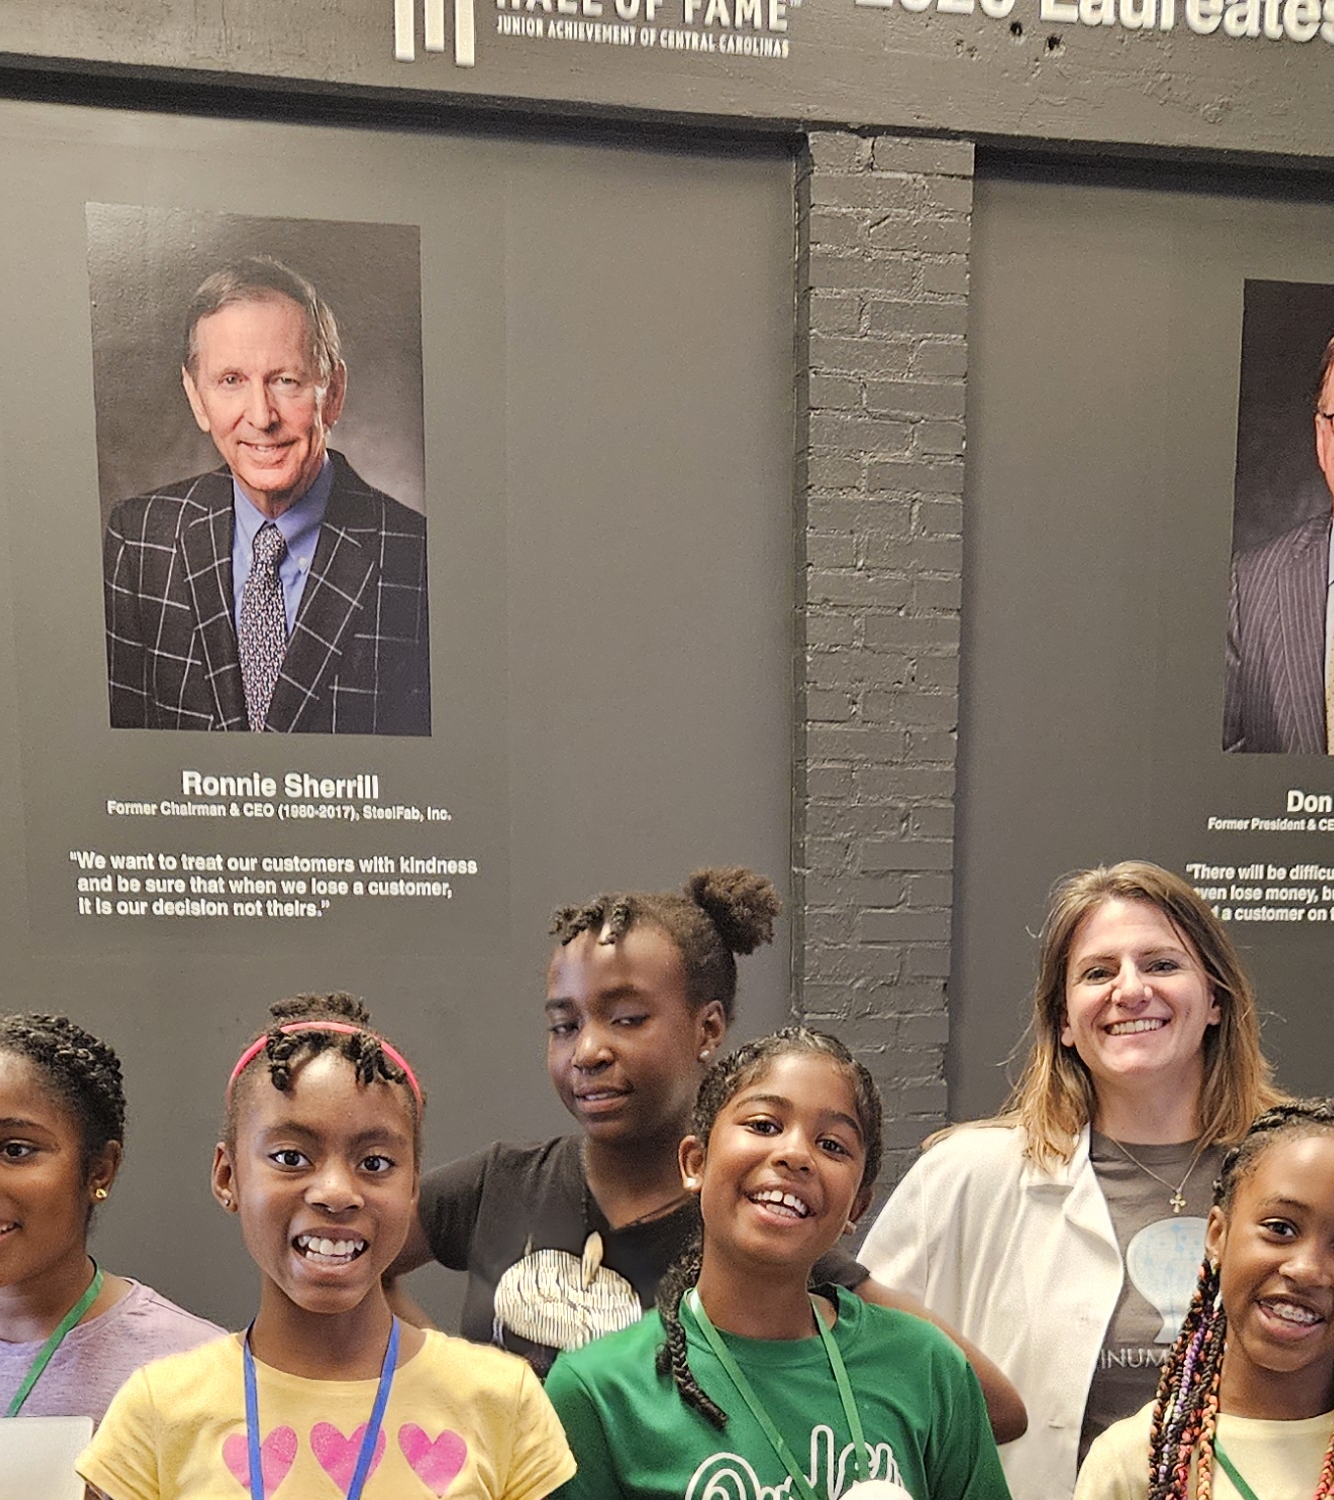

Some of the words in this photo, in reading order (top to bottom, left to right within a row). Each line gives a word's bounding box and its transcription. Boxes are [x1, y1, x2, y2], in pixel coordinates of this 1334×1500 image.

[496, 15, 544, 37] JUNIOR
[547, 20, 637, 45] ACHIEVEMENT
[640, 27, 657, 47] OF
[660, 29, 715, 52] CENTRAL
[719, 34, 789, 58] CAROLINAS
[182, 770, 277, 798] Ronnie
[284, 773, 379, 800] Sherrill
[107, 800, 158, 816] Former
[160, 801, 227, 817] Chairman
[230, 803, 241, 817] &
[243, 803, 275, 818] CEO
[278, 804, 360, 822] (1980-2017),
[362, 805, 425, 823] SteelFab,
[427, 806, 452, 821] Inc.
[1286, 790, 1333, 813] Don
[1208, 817, 1250, 831] Former
[1251, 818, 1306, 831] President
[1307, 819, 1317, 831] &
[110, 853, 155, 871] want
[157, 854, 178, 871] to
[180, 854, 224, 871] treat
[227, 858, 258, 872] our
[261, 856, 356, 873] customers
[358, 856, 396, 874] with
[399, 856, 478, 875] kindness
[1237, 864, 1265, 880] will
[1266, 864, 1287, 880] be
[77, 874, 113, 892] and
[117, 875, 142, 893] be
[145, 879, 186, 893] sure
[189, 876, 226, 893] that
[228, 877, 277, 894] when
[280, 880, 308, 895] we
[311, 878, 349, 895] lose
[352, 881, 364, 895] a
[367, 880, 454, 899] customer,
[1230, 885, 1263, 901] lose
[1265, 888, 1319, 905] money,
[95, 897, 113, 914] is
[116, 901, 149, 915] our
[151, 898, 230, 916] decision
[232, 900, 263, 917] not
[1221, 907, 1233, 921] a
[1234, 906, 1305, 922] customer
[1307, 908, 1328, 921] on
